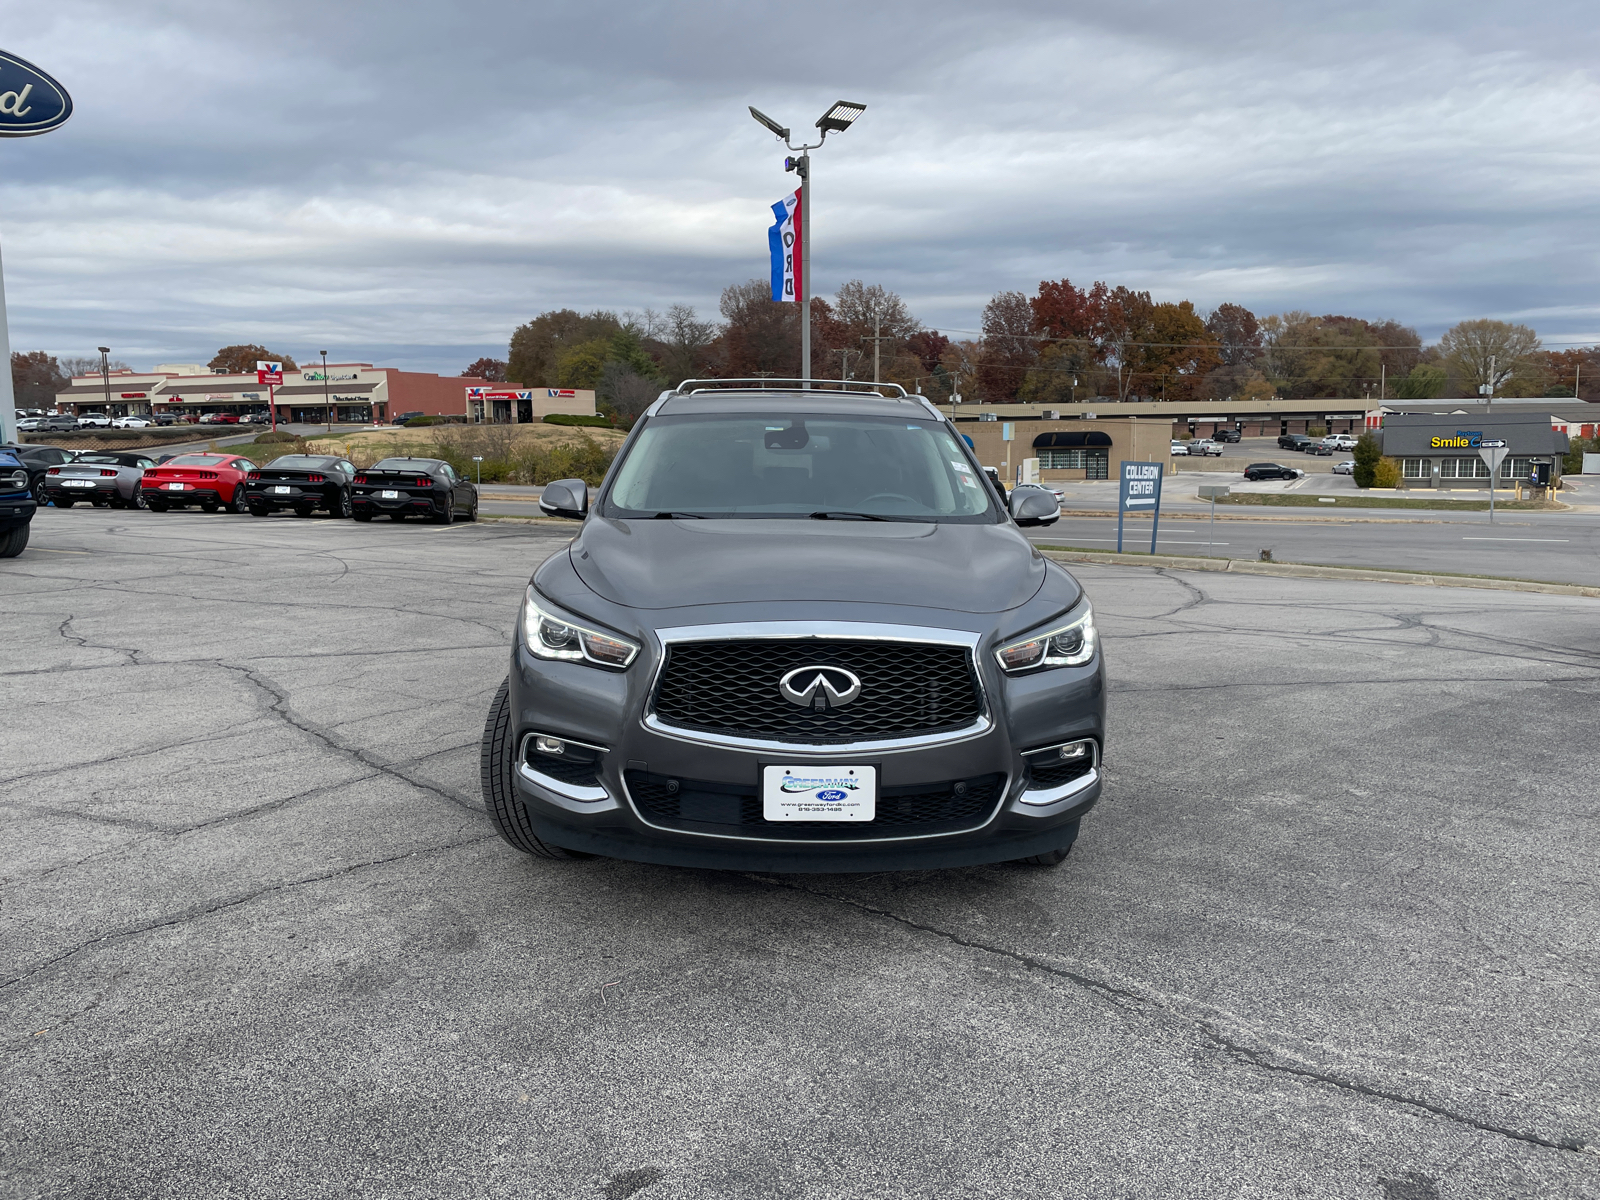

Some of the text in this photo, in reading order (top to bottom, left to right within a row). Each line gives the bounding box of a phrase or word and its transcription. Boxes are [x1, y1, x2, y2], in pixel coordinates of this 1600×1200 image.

[1431, 436, 1469, 448] Smile
[1125, 465, 1159, 480] COLLISION
[1129, 481, 1154, 495] CENTER
[822, 791, 842, 800] Ford
